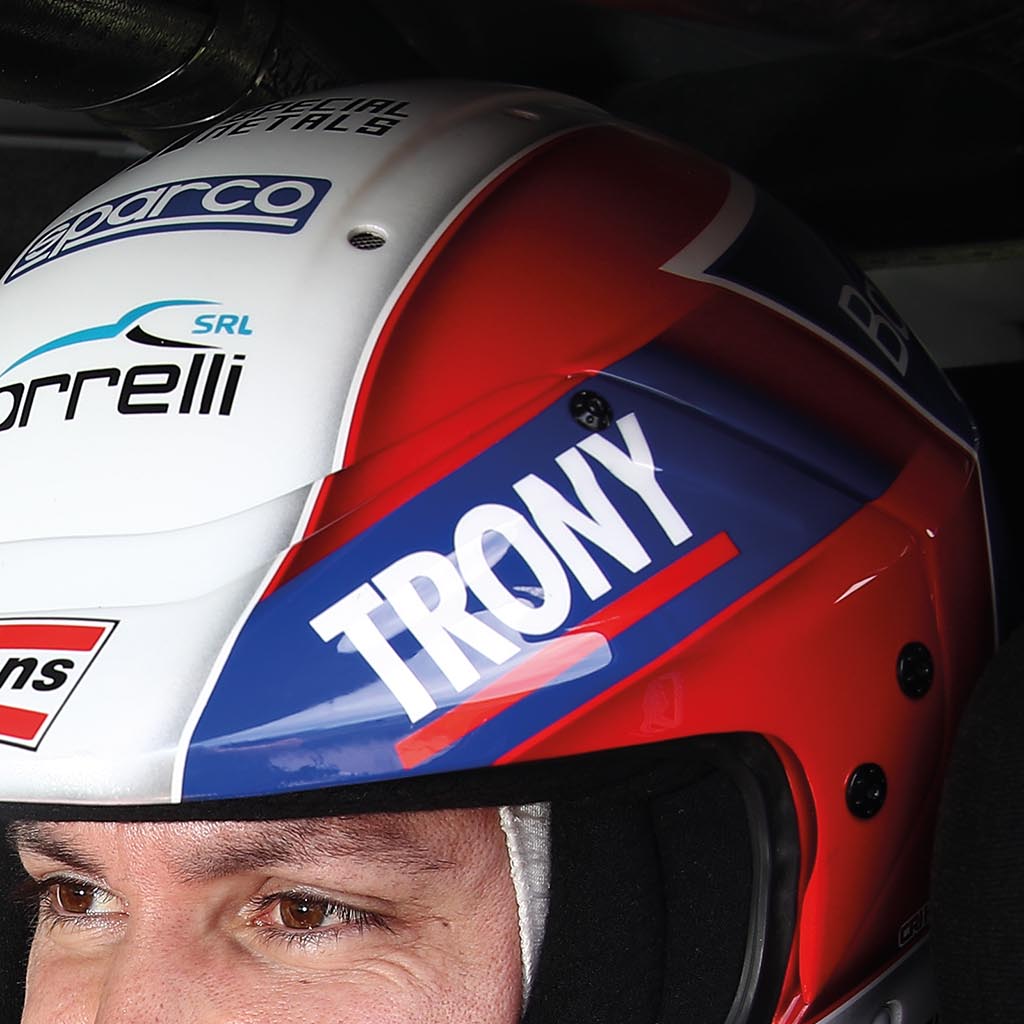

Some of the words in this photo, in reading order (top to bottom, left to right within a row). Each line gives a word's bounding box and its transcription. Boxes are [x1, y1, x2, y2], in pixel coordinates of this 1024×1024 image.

[25, 179, 316, 262] sparco
[191, 314, 253, 335] SRL
[309, 413, 693, 723] TRONY
